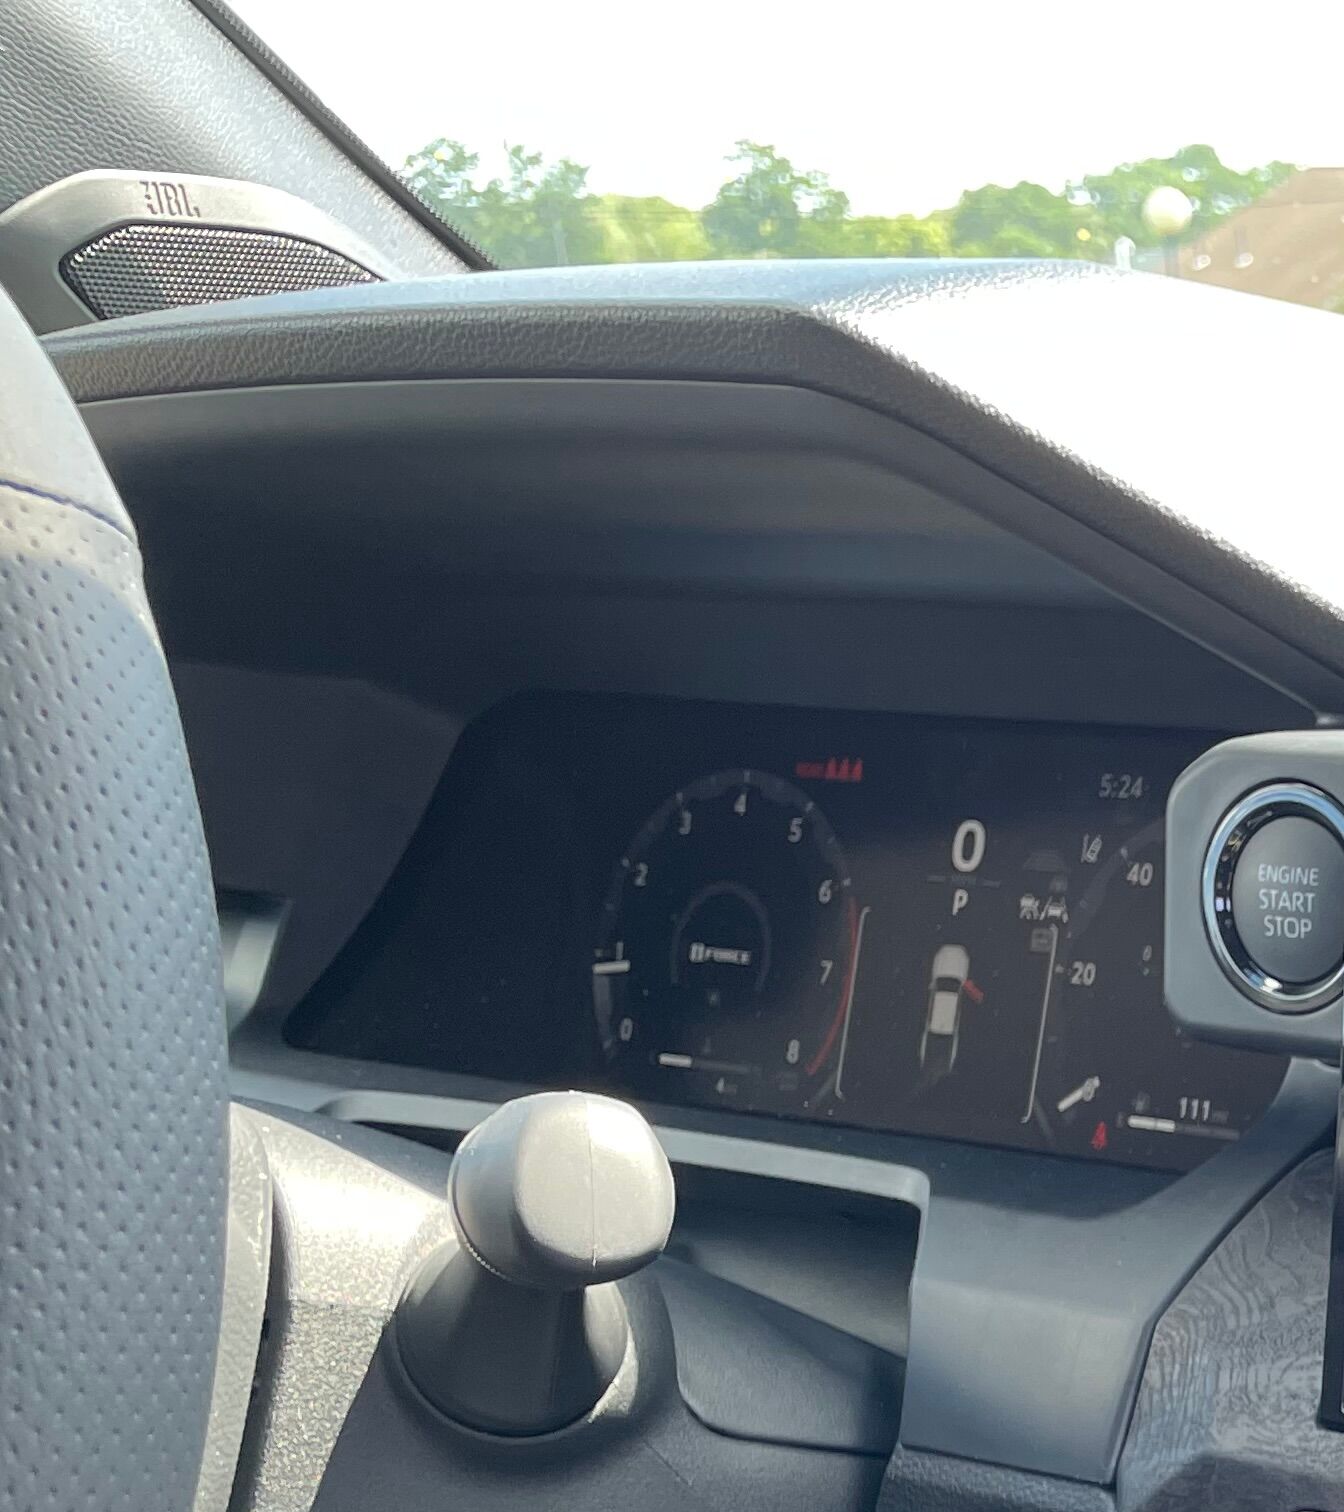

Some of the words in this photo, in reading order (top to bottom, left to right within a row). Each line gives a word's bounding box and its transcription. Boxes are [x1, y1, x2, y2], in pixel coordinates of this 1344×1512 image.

[139, 181, 201, 218] JBL
[1099, 773, 1144, 798] 5:24
[734, 791, 748, 816] 4
[678, 809, 693, 836] 3
[787, 816, 804, 843] 5
[951, 819, 987, 873] 0
[633, 861, 649, 887] 2
[1126, 861, 1155, 888] 40
[1257, 863, 1319, 887] ENGINE
[818, 879, 833, 904] 6
[952, 888, 969, 916] P
[1258, 888, 1316, 913] START
[1263, 914, 1313, 939] STOP
[819, 960, 834, 986] 7
[1070, 960, 1097, 987] 20
[620, 1017, 633, 1041] 0
[786, 1039, 800, 1064] 8
